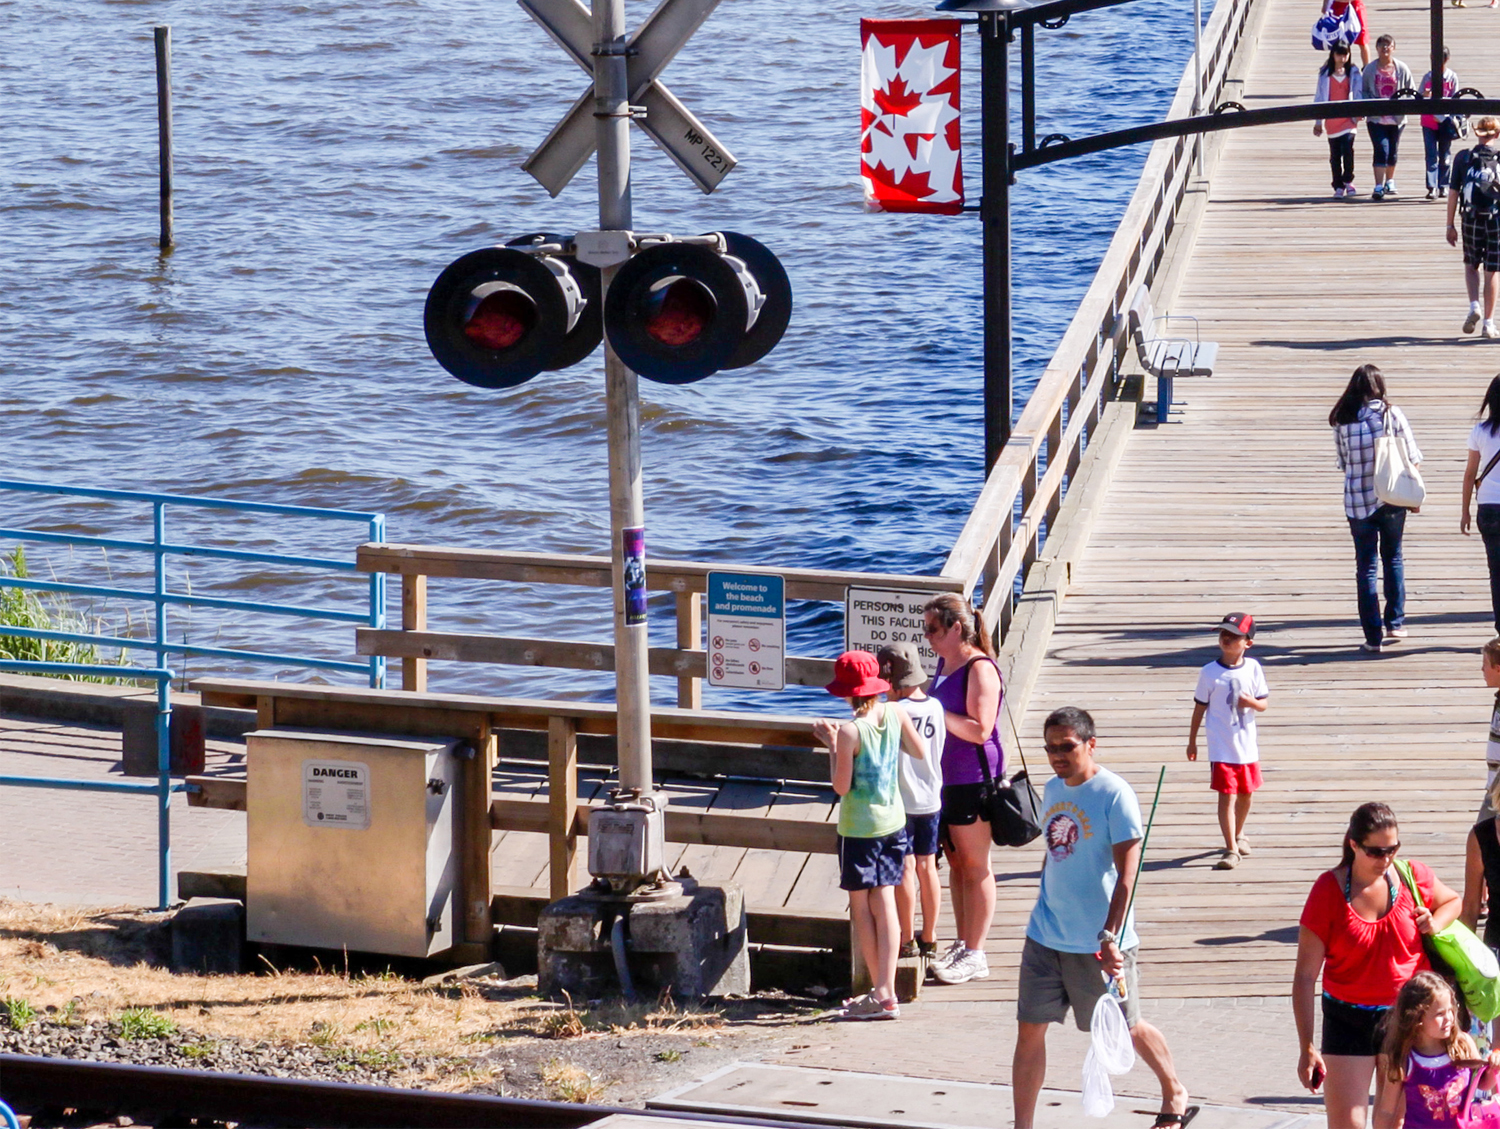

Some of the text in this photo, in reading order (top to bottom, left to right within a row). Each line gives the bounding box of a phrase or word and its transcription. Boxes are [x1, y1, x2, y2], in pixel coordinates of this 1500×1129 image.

[684, 129, 728, 174] MP 122.1
[722, 581, 768, 593] Welcome to
[726, 592, 764, 602] the beach
[715, 602, 777, 614] and promenade
[853, 600, 904, 613] PERSONS
[861, 615, 926, 628] THIS FACILIT
[871, 630, 924, 643] DO SO AT
[911, 715, 936, 739] 76
[313, 768, 358, 779] DANGER
